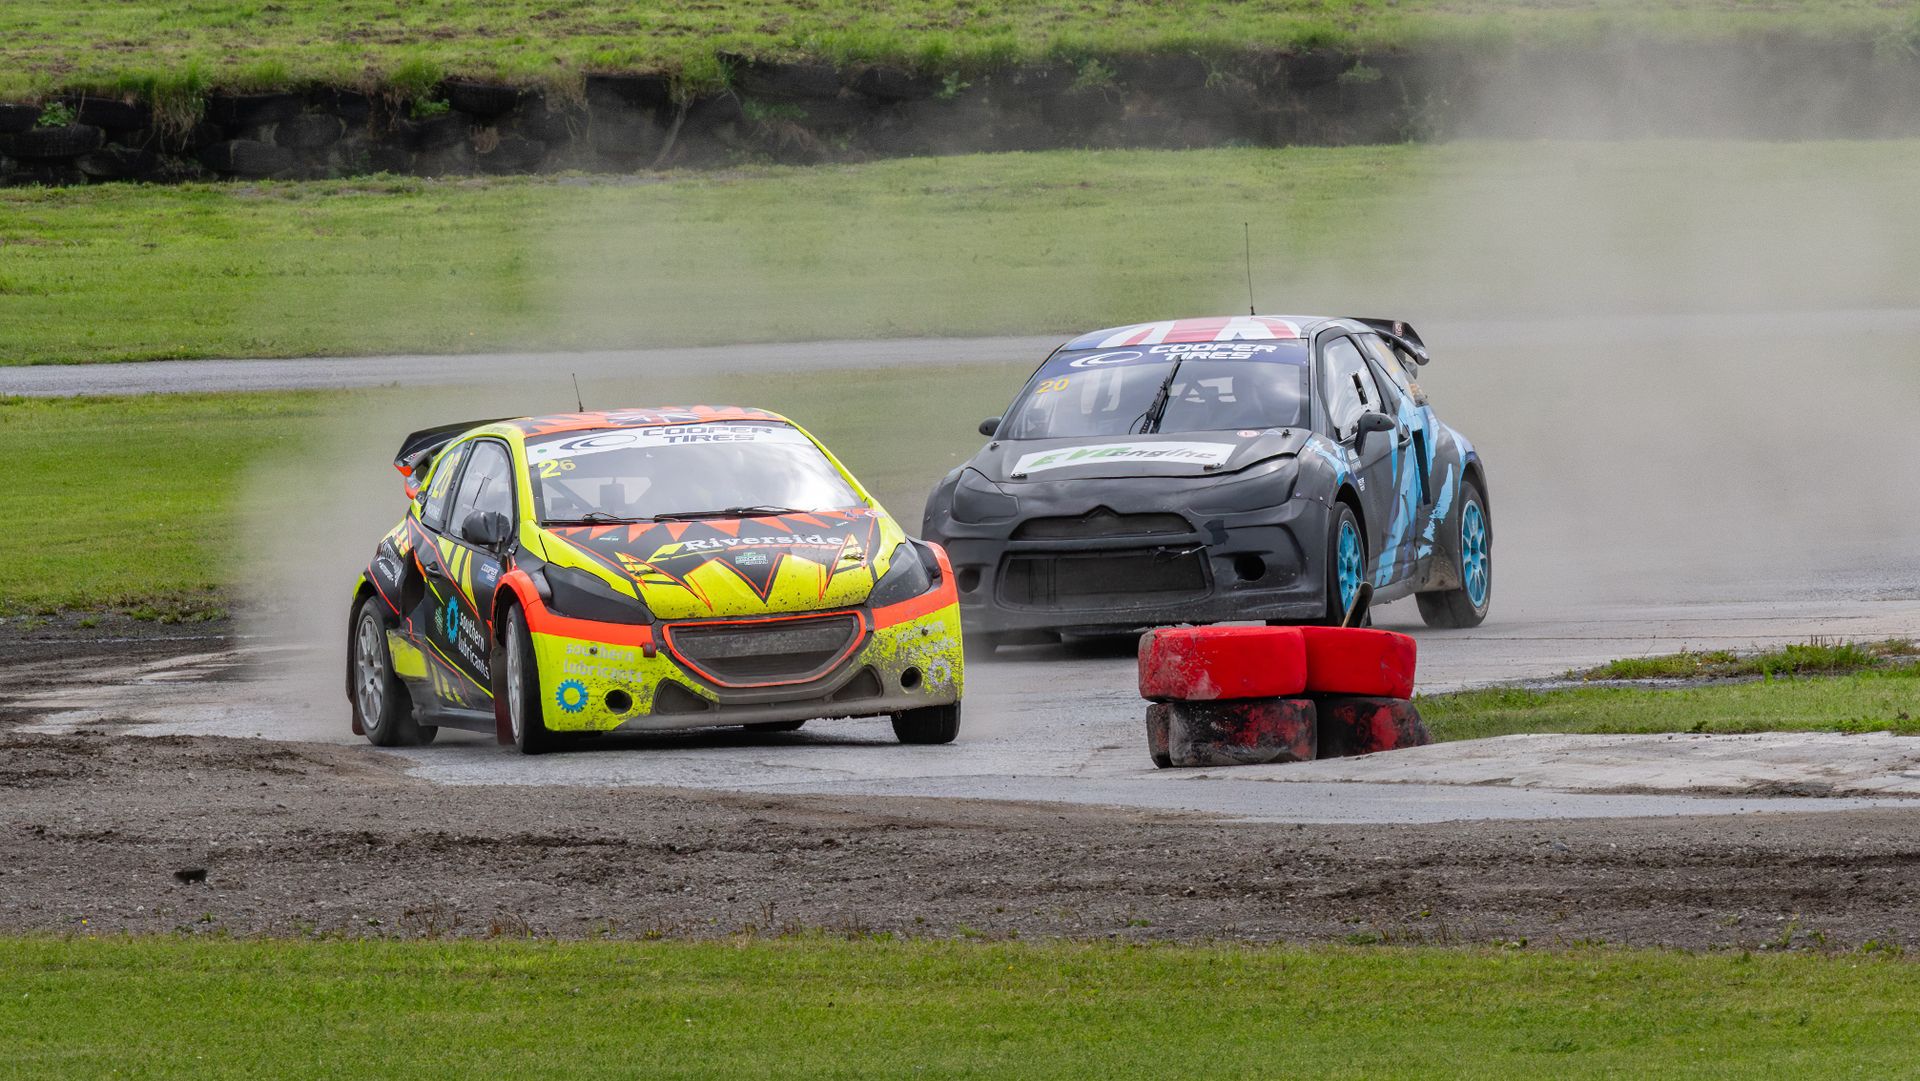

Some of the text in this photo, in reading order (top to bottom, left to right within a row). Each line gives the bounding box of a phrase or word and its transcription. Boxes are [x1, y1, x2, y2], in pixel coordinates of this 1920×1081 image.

[1149, 343, 1278, 354] COOPER
[1165, 351, 1254, 361] TIRES
[1036, 376, 1070, 395] 20
[643, 426, 773, 437] COOPER
[663, 434, 755, 443] TIRES
[682, 533, 844, 552] Riverside
[565, 643, 635, 663] southern
[563, 658, 643, 683] lubricants
